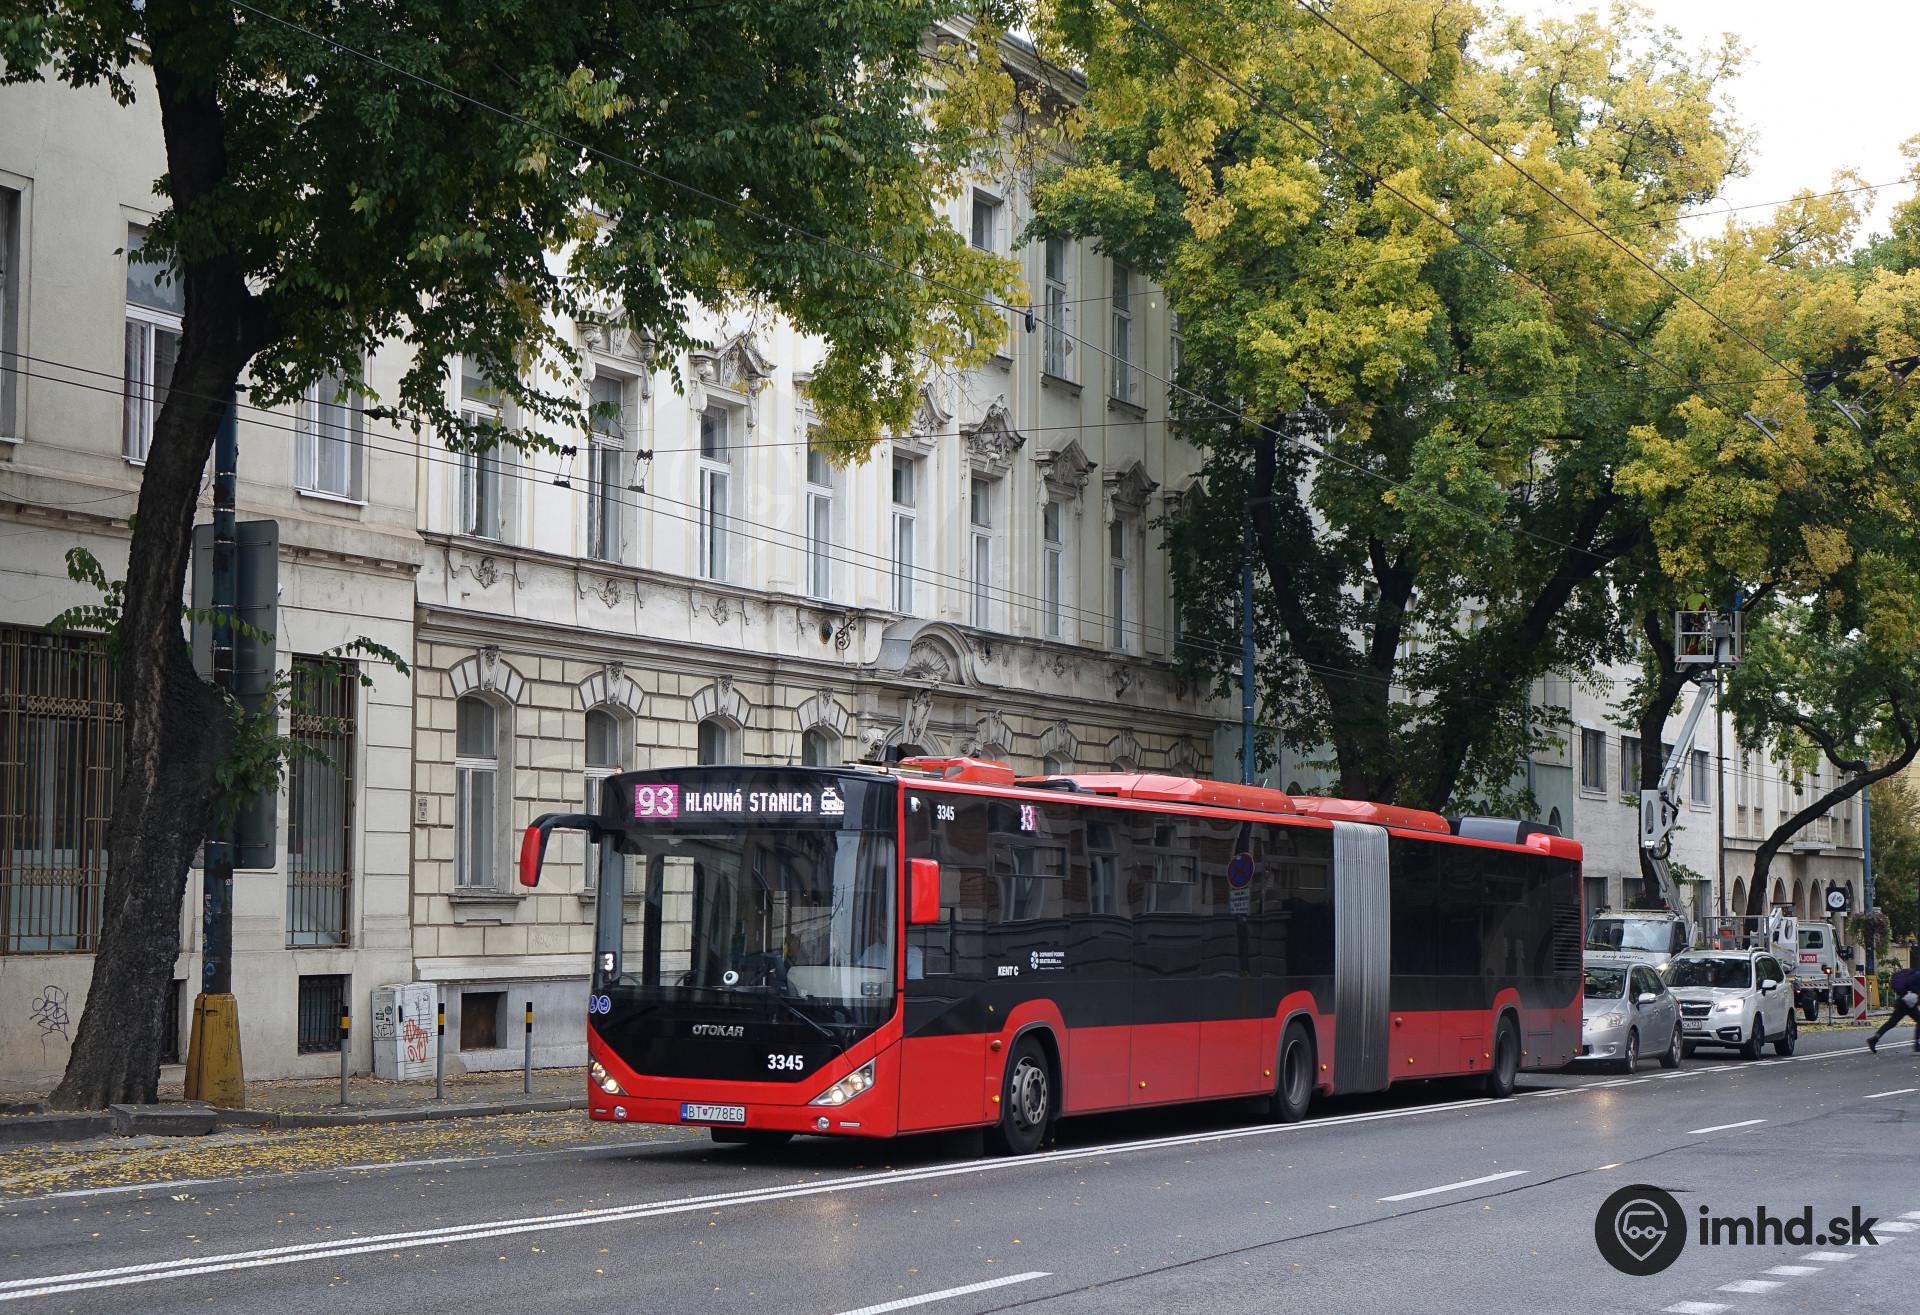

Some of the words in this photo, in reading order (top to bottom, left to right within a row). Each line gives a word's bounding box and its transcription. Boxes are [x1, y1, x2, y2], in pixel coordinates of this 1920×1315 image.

[638, 786, 674, 816] 93
[685, 788, 742, 812] HLAVNÁ
[749, 792, 812, 812] STANICA
[936, 804, 955, 821] 3345
[997, 965, 1013, 977] KENT
[1013, 965, 1019, 976] C
[692, 1024, 744, 1037] OTOKAR
[767, 1054, 804, 1071] 3345
